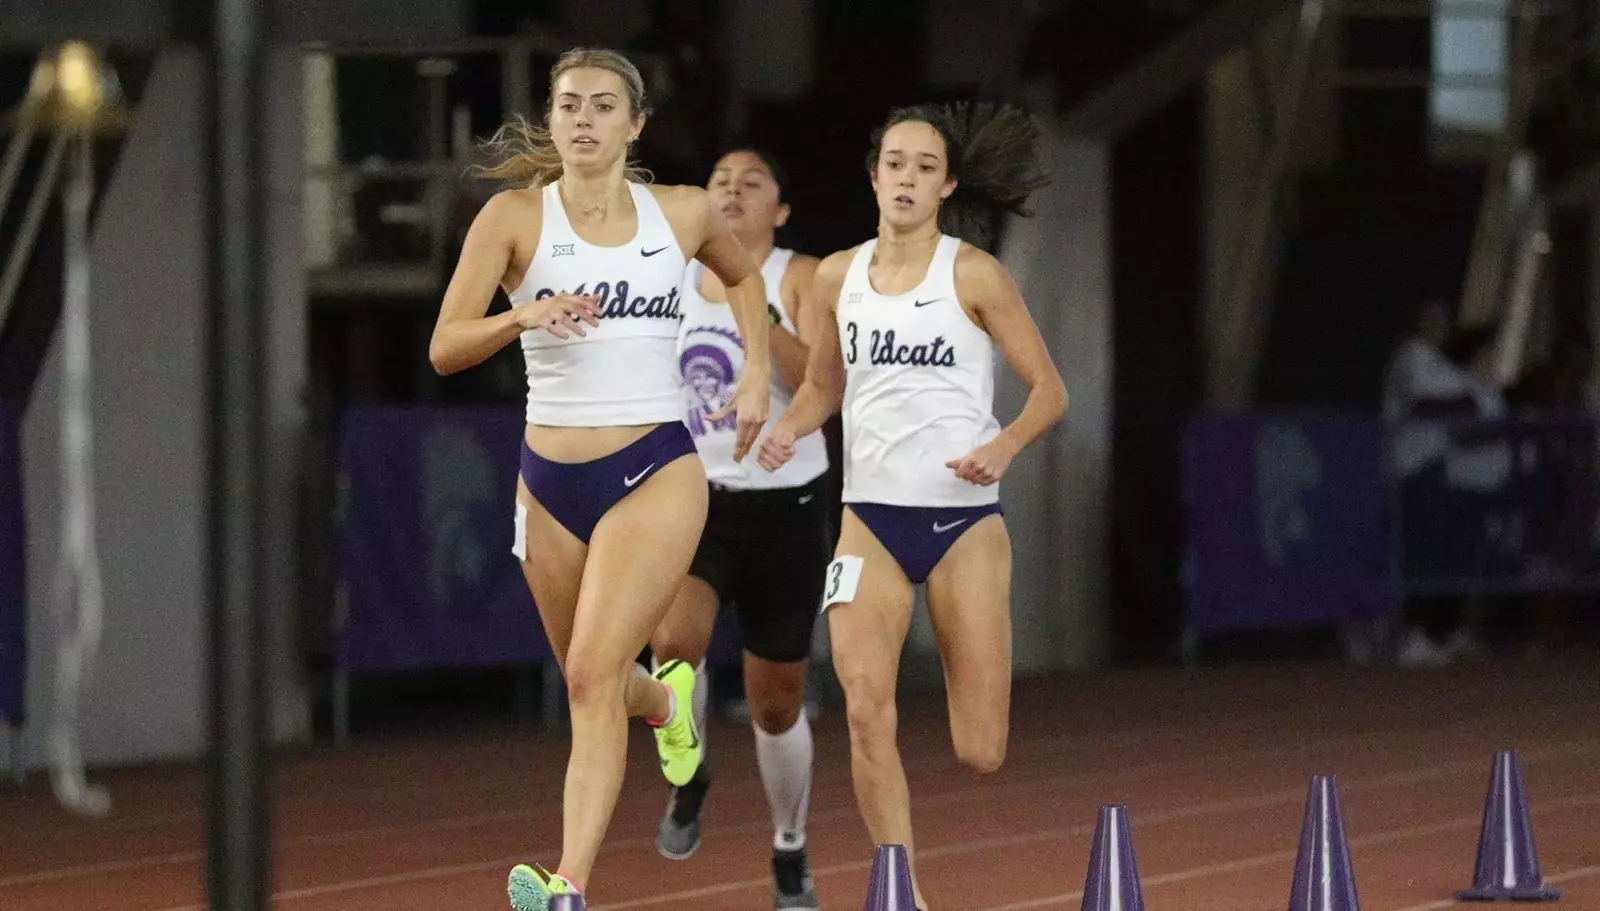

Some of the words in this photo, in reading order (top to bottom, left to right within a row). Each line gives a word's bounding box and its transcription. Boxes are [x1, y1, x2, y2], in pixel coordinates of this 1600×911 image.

[535, 280, 684, 323] ldcats
[846, 321, 858, 365] 3
[827, 561, 844, 600] 3
